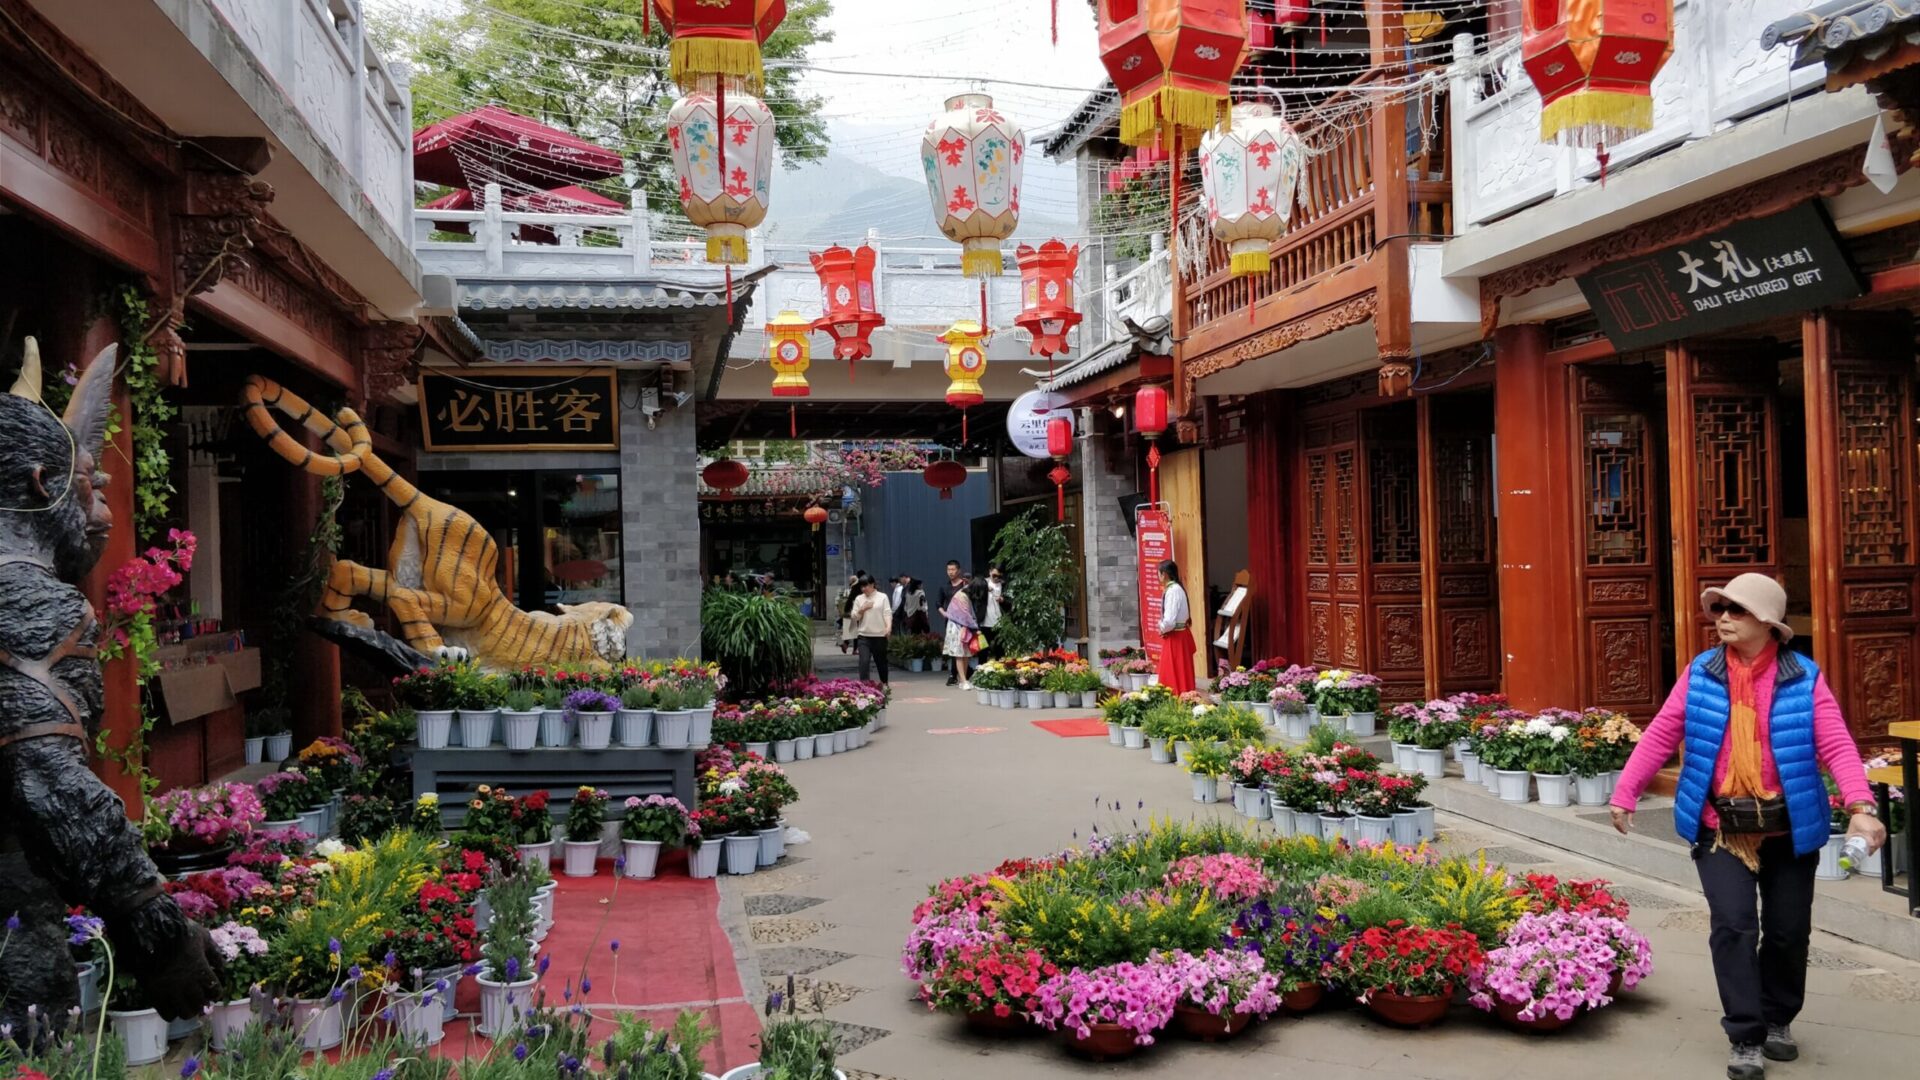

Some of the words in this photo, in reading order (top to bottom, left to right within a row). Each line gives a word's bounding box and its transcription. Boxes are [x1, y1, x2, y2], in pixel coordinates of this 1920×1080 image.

[1677, 240, 1761, 293] 大礼
[1693, 295, 1722, 311] DALI
[1723, 277, 1789, 304] FEATURED
[1792, 268, 1822, 287] GIFT
[437, 388, 601, 433] 必胜客
